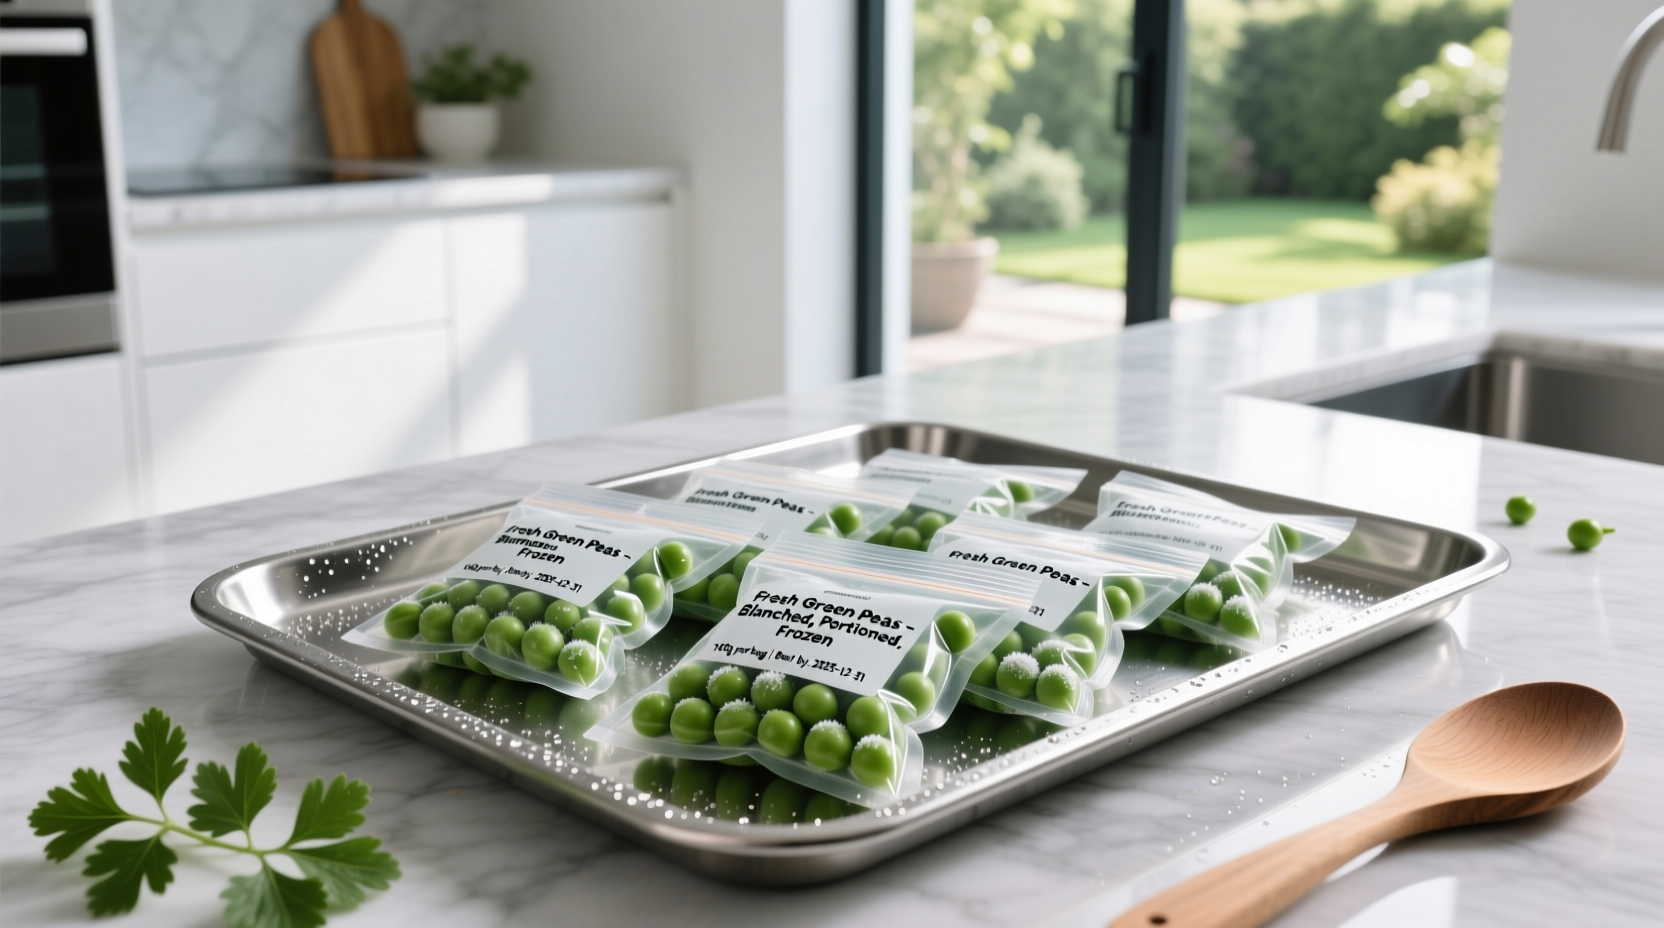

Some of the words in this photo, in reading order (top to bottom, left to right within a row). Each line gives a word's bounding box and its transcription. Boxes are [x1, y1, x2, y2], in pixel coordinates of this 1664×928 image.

[517, 547, 566, 565] Frozen
[543, 530, 584, 547] Green
[585, 539, 622, 558] Peas
[949, 550, 989, 564] Fresh
[1039, 565, 1080, 587] Peas
[753, 590, 799, 606] Fresh
[802, 597, 855, 618] Green
[857, 609, 902, 630] Peas
[738, 604, 814, 629] Blanched,
[819, 615, 903, 650] Portioned,
[775, 624, 834, 647] Frozen
